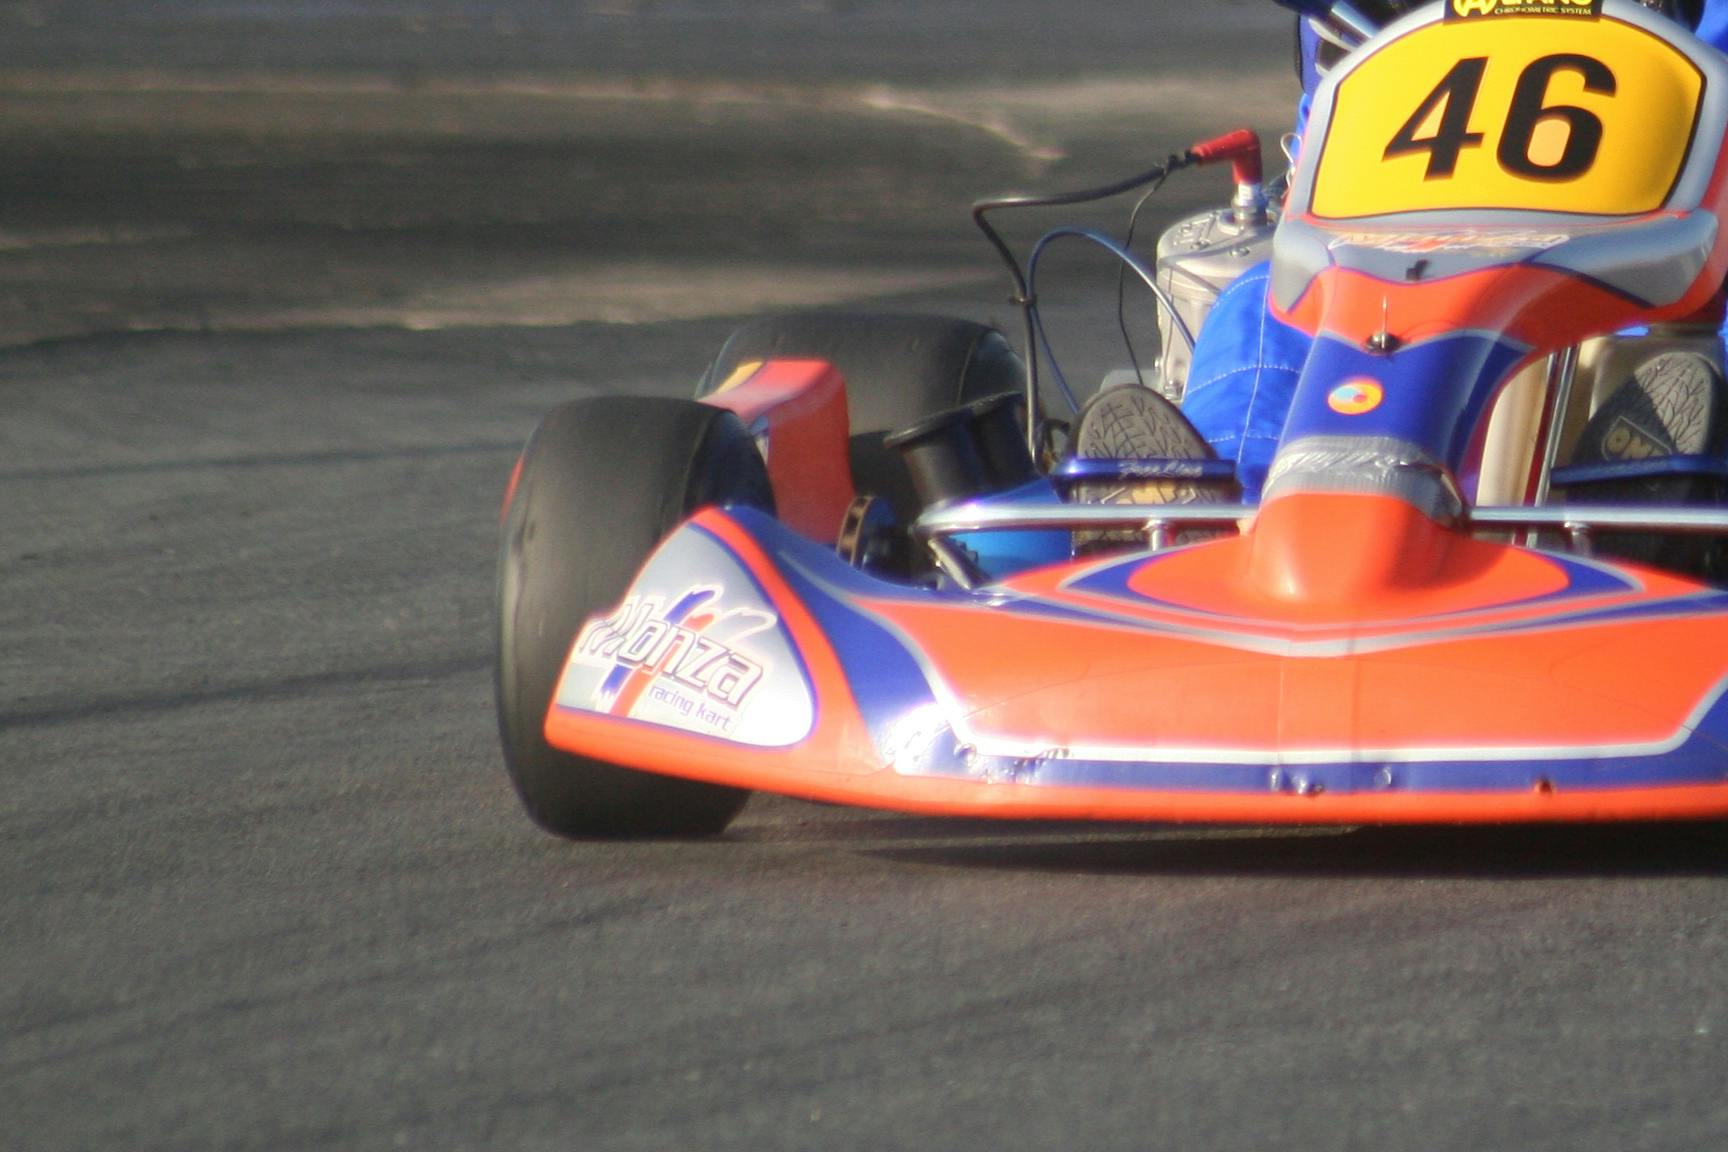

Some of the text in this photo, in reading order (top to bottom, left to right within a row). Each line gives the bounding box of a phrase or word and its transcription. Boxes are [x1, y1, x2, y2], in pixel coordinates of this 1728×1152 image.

[1560, 6, 1593, 16] SYSTEM
[1381, 52, 1617, 184] 46
[579, 603, 763, 711] Monza
[648, 685, 731, 731] racing kart
